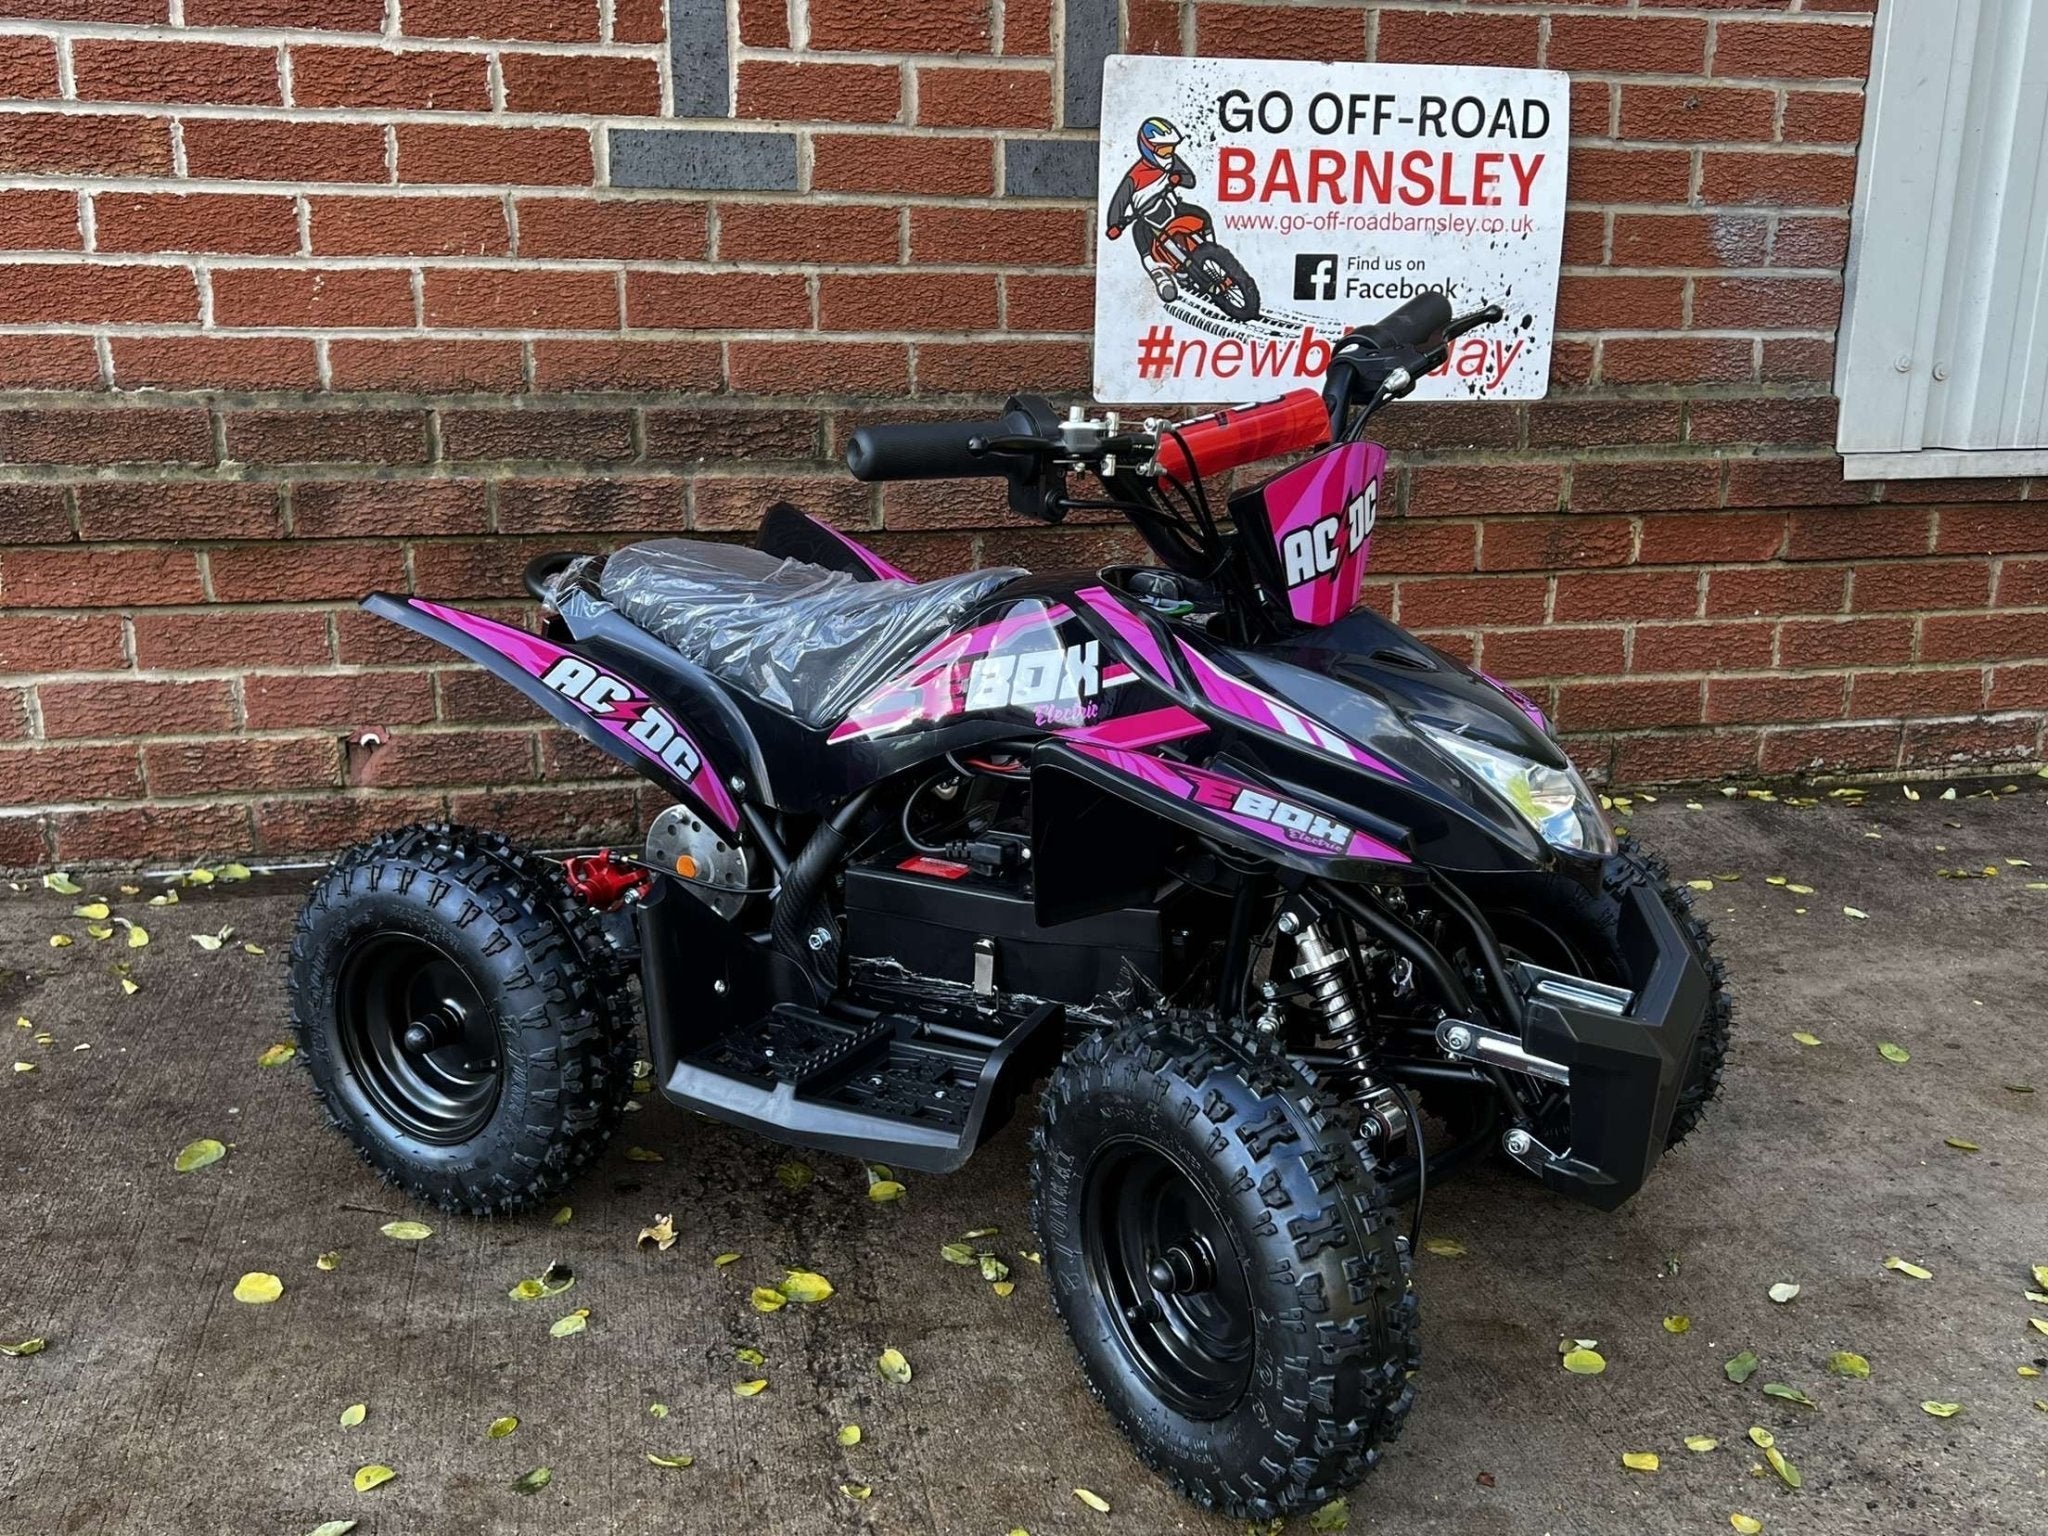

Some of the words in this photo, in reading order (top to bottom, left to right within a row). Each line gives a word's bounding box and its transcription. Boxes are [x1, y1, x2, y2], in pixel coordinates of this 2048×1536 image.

[1217, 88, 1294, 134] GO
[1308, 91, 1551, 140] OFF-ROAD
[1216, 147, 1546, 208] BARNSLEY
[1224, 209, 1534, 236] www.go-off-roadbarnsley.co.uk
[1347, 256, 1380, 271] Find
[1385, 259, 1402, 271] us
[1406, 259, 1426, 271] on
[1346, 276, 1458, 300] Facebook
[1137, 323, 1524, 389] #newbay
[1033, 700, 1099, 727] Electric
[1287, 827, 1343, 854] Electric
